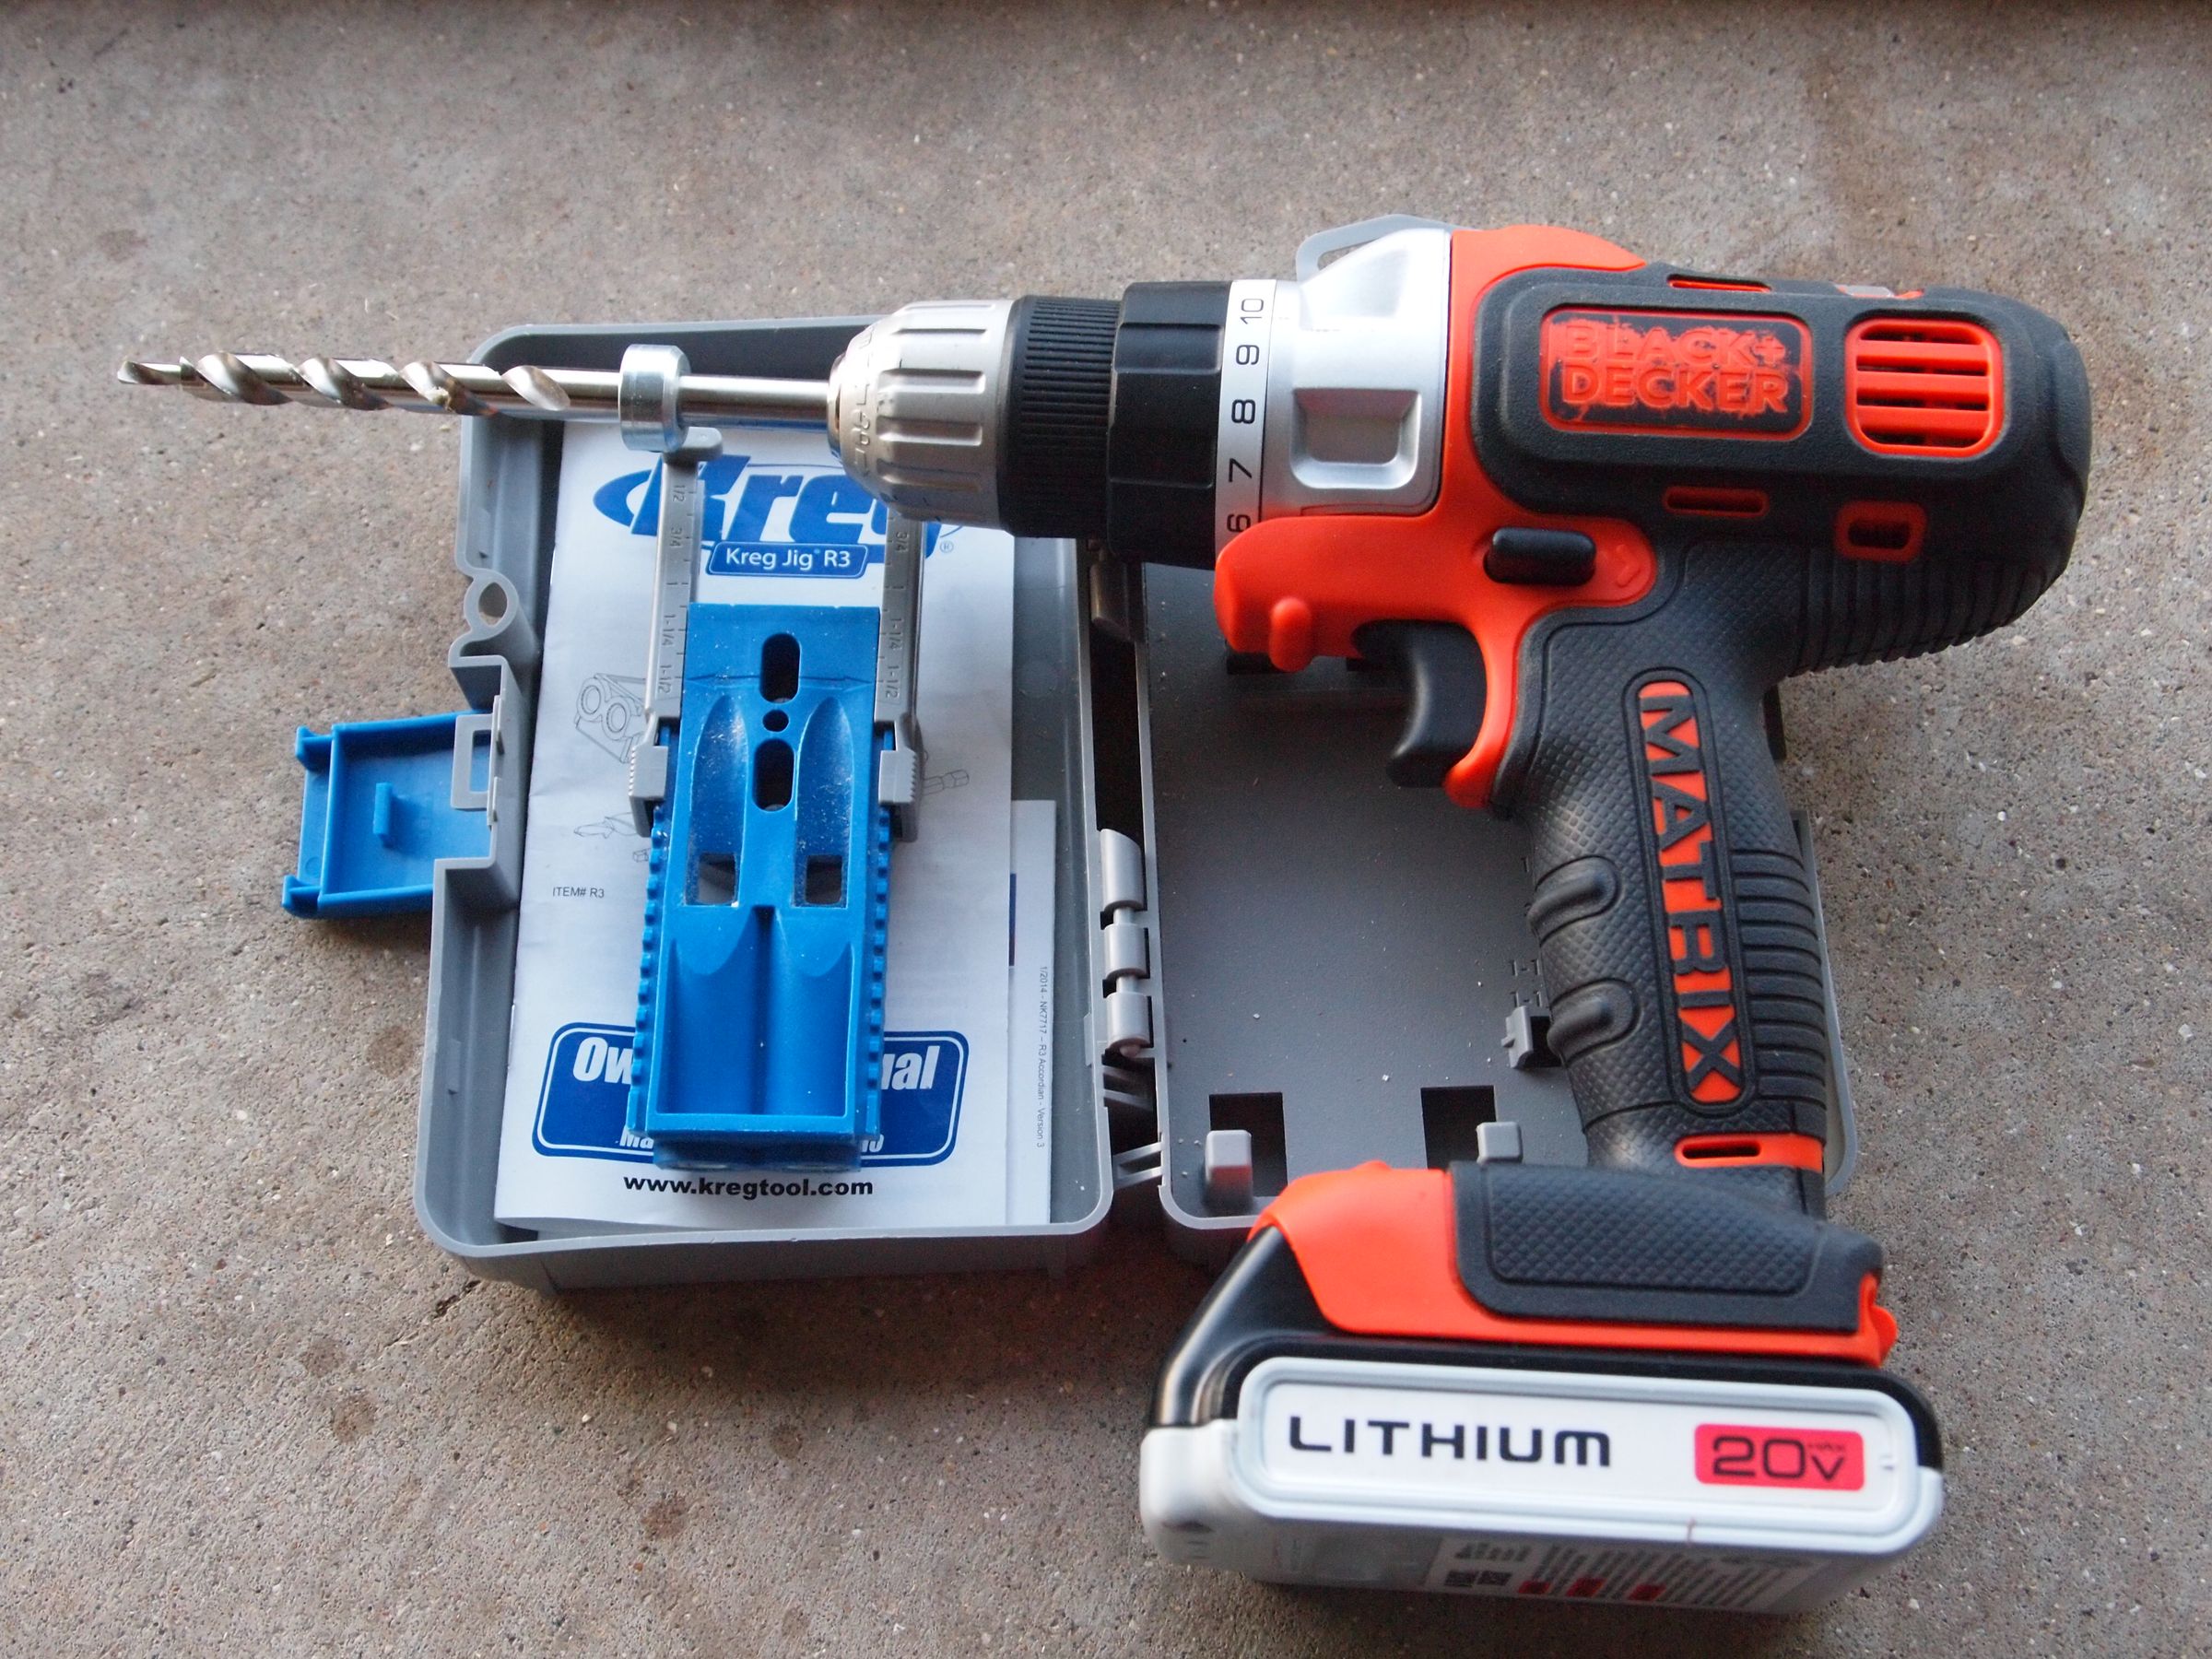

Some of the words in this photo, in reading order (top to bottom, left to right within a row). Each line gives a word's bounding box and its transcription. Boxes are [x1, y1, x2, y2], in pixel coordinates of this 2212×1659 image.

[1240, 297, 1265, 324] 10
[1562, 363, 1788, 413] DECKER
[1231, 398, 1256, 425] 8
[1228, 457, 1253, 483] 7
[629, 454, 942, 560] Kre
[725, 547, 776, 571] Kreg
[781, 547, 813, 571] Jig
[823, 550, 851, 568] R3
[552, 886, 587, 898] ITEM#
[590, 887, 606, 899] R3
[1641, 694, 1744, 1090] MATRIX
[1038, 1043, 1048, 1057] R3
[1036, 1107, 1046, 1140] Version
[622, 1175, 874, 1201] www.kregtool.com
[1289, 1415, 1611, 1467] LITHIUM
